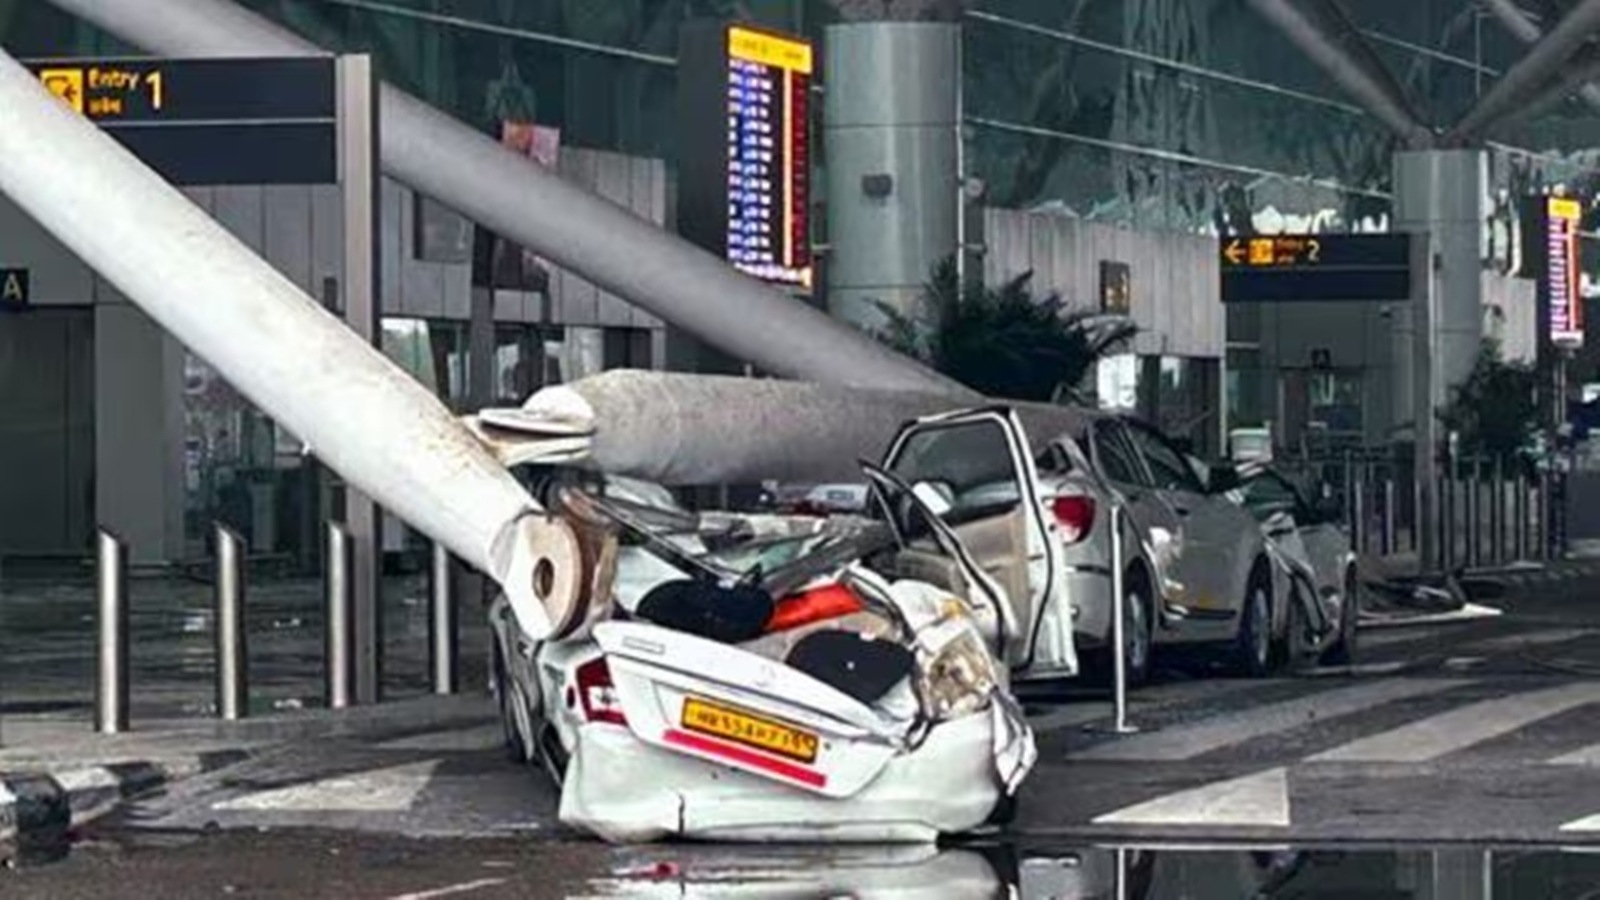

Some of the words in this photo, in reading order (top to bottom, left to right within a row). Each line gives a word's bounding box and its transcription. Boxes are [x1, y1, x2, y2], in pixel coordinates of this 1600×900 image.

[146, 71, 160, 109] 1
[1308, 240, 1319, 261] 2
[4, 273, 22, 299] A
